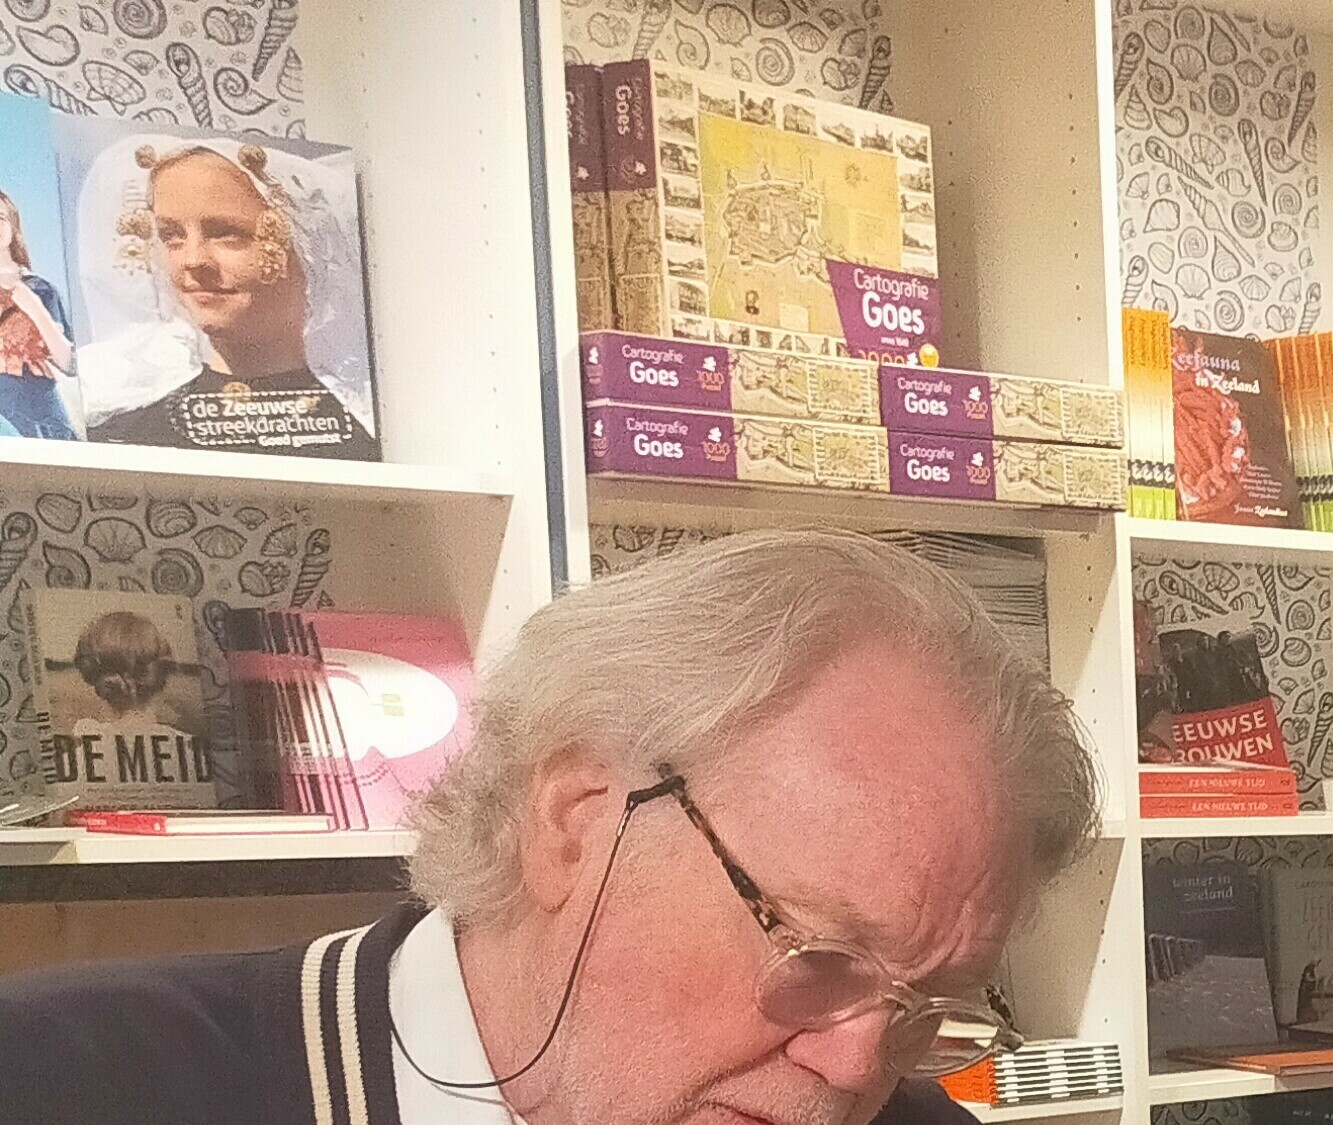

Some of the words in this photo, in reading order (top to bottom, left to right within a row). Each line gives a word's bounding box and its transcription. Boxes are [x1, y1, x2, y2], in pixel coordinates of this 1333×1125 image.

[853, 267, 929, 301] Cartografie
[861, 290, 925, 336] Goes
[621, 344, 685, 364] Cartografie
[629, 360, 680, 388] Goes
[896, 376, 953, 396] Cartografie
[1204, 369, 1261, 395] Zeeland
[192, 399, 219, 419] de
[220, 399, 309, 418] Zeeuwse
[904, 391, 949, 417] Goes
[195, 415, 341, 437] streekdrachten
[625, 417, 689, 438] Cartografie
[633, 433, 684, 459] Goes
[899, 443, 956, 462] Cartografie
[906, 458, 951, 483] Goes
[1172, 708, 1268, 743] EEUWSE
[53, 733, 107, 784] DE
